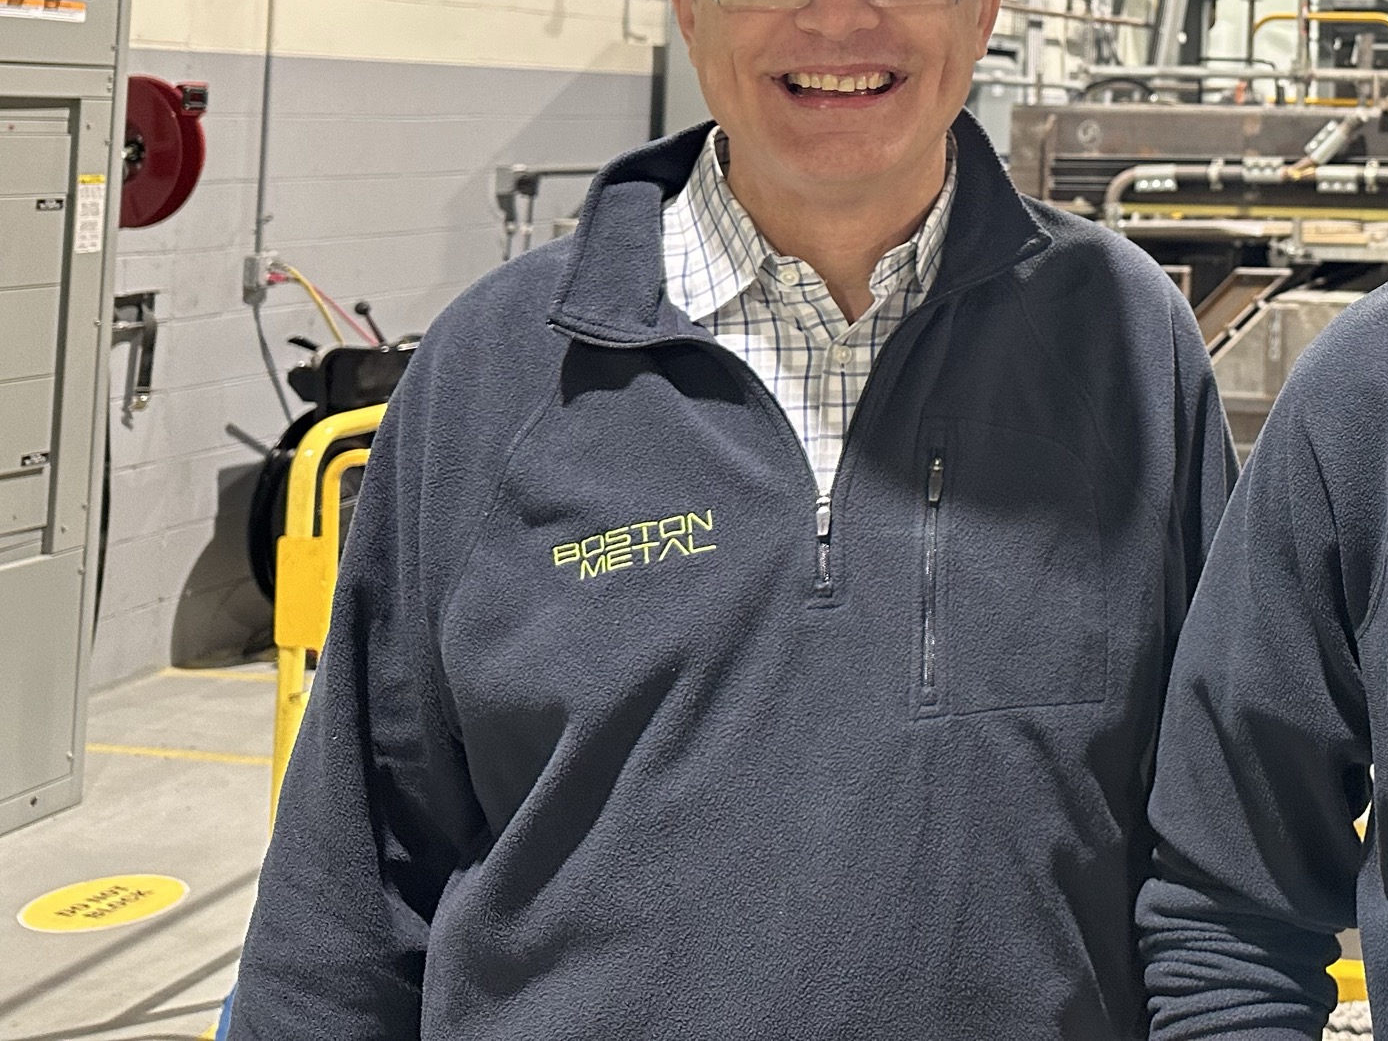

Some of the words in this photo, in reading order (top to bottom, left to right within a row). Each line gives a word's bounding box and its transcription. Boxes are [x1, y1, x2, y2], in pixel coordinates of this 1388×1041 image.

[552, 509, 713, 566] BOSTON
[579, 534, 717, 580] METAL
[54, 903, 90, 917] DO
[86, 885, 129, 904] NOT
[83, 890, 155, 919] BLOCK
